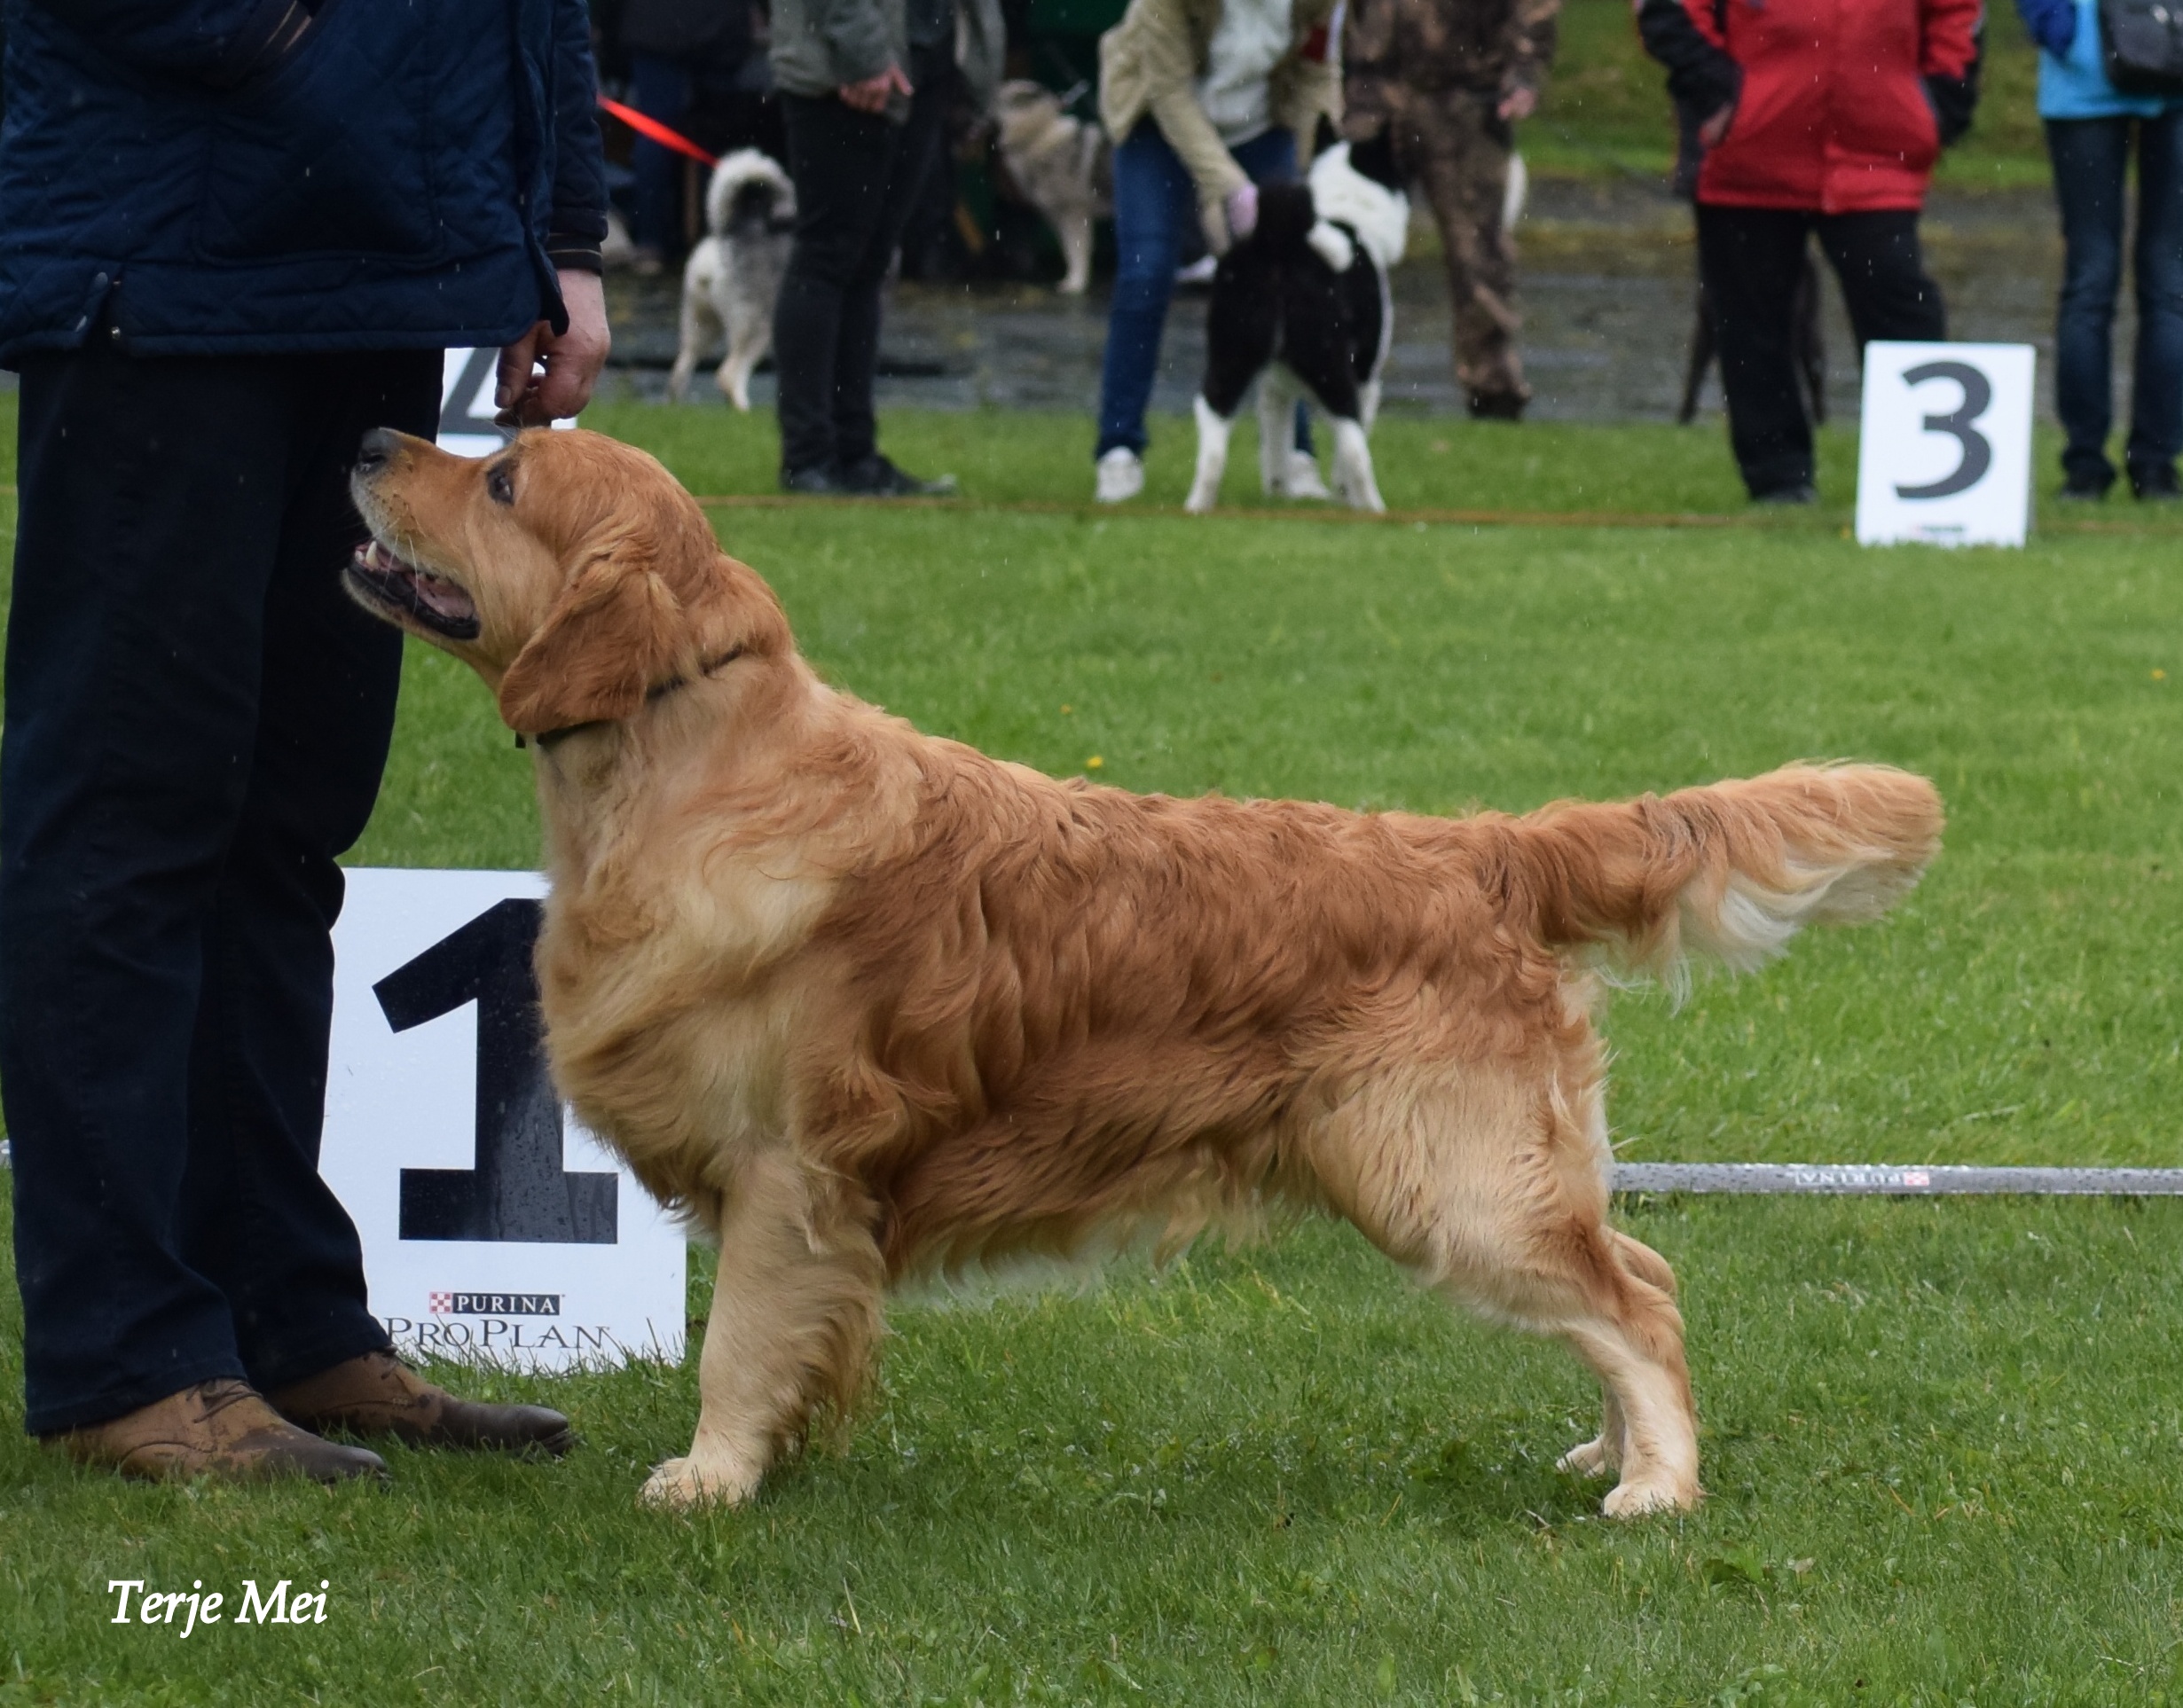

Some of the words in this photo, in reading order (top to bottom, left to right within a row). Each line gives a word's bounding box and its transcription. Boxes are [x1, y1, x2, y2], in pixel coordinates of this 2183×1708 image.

[1895, 360, 1991, 499] 3
[372, 897, 618, 1245] 1
[456, 1295, 556, 1313] PURINA
[479, 1319, 609, 1350] PLAN
